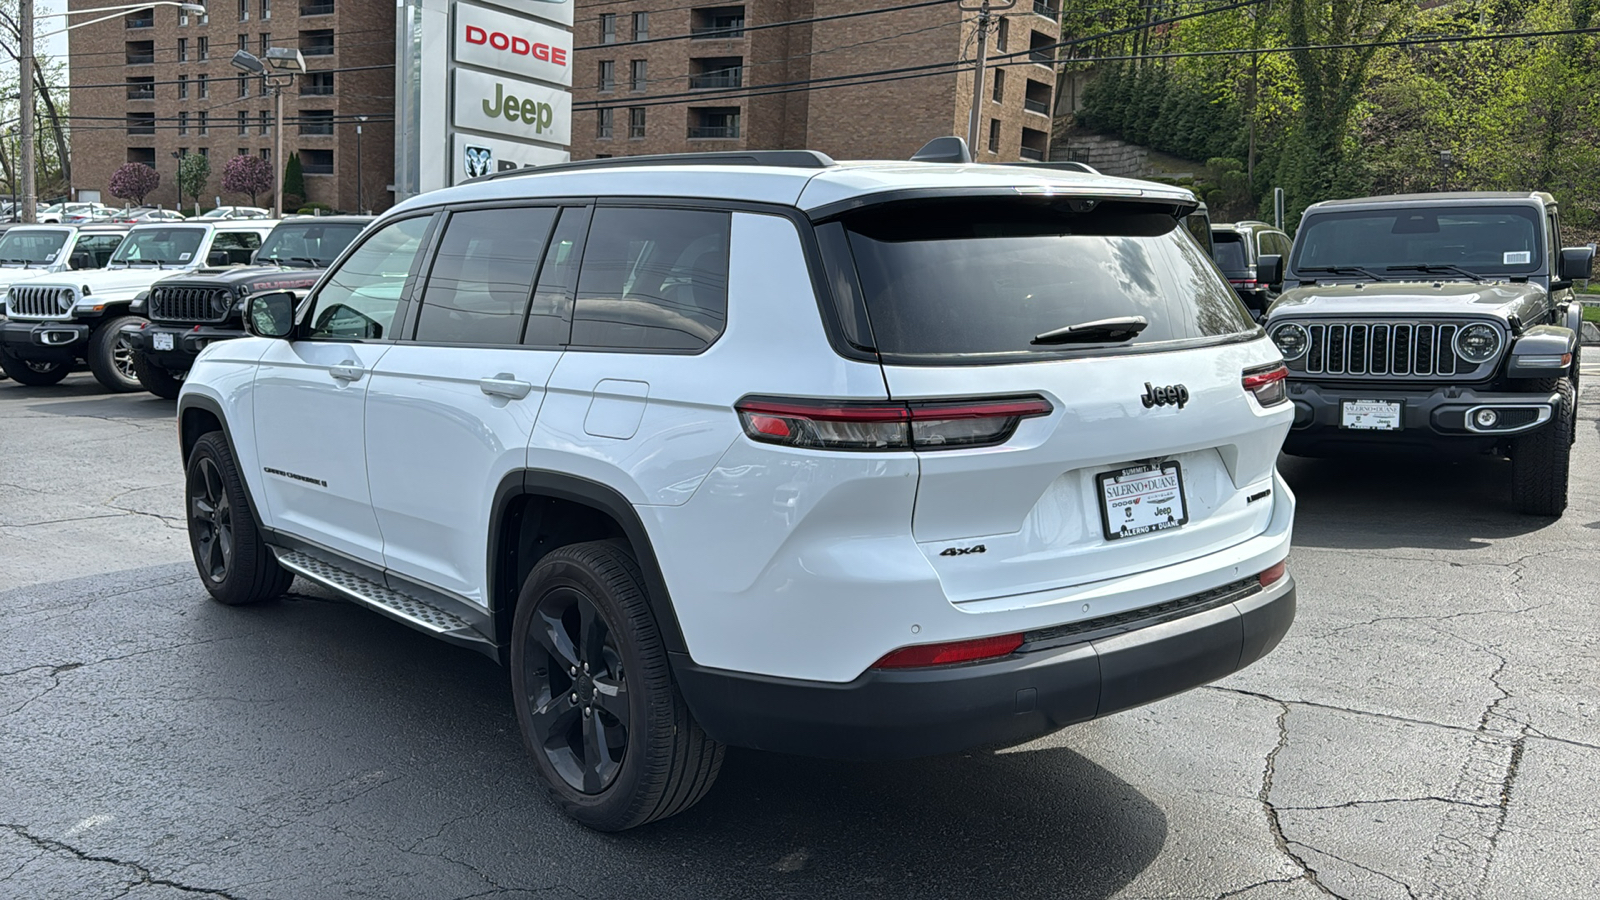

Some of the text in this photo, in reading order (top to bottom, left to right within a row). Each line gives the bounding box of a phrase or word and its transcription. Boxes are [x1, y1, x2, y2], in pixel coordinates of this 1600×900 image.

[466, 24, 567, 67] DODGE
[482, 82, 553, 135] Jeep
[253, 279, 317, 290] RUBICO
[1140, 382, 1189, 410] Jeep
[1106, 476, 1177, 498] SALERNO DUANE
[1154, 506, 1172, 517] Jeep
[1119, 520, 1180, 538] SALERNO DUANE
[939, 544, 987, 556] 4x4
